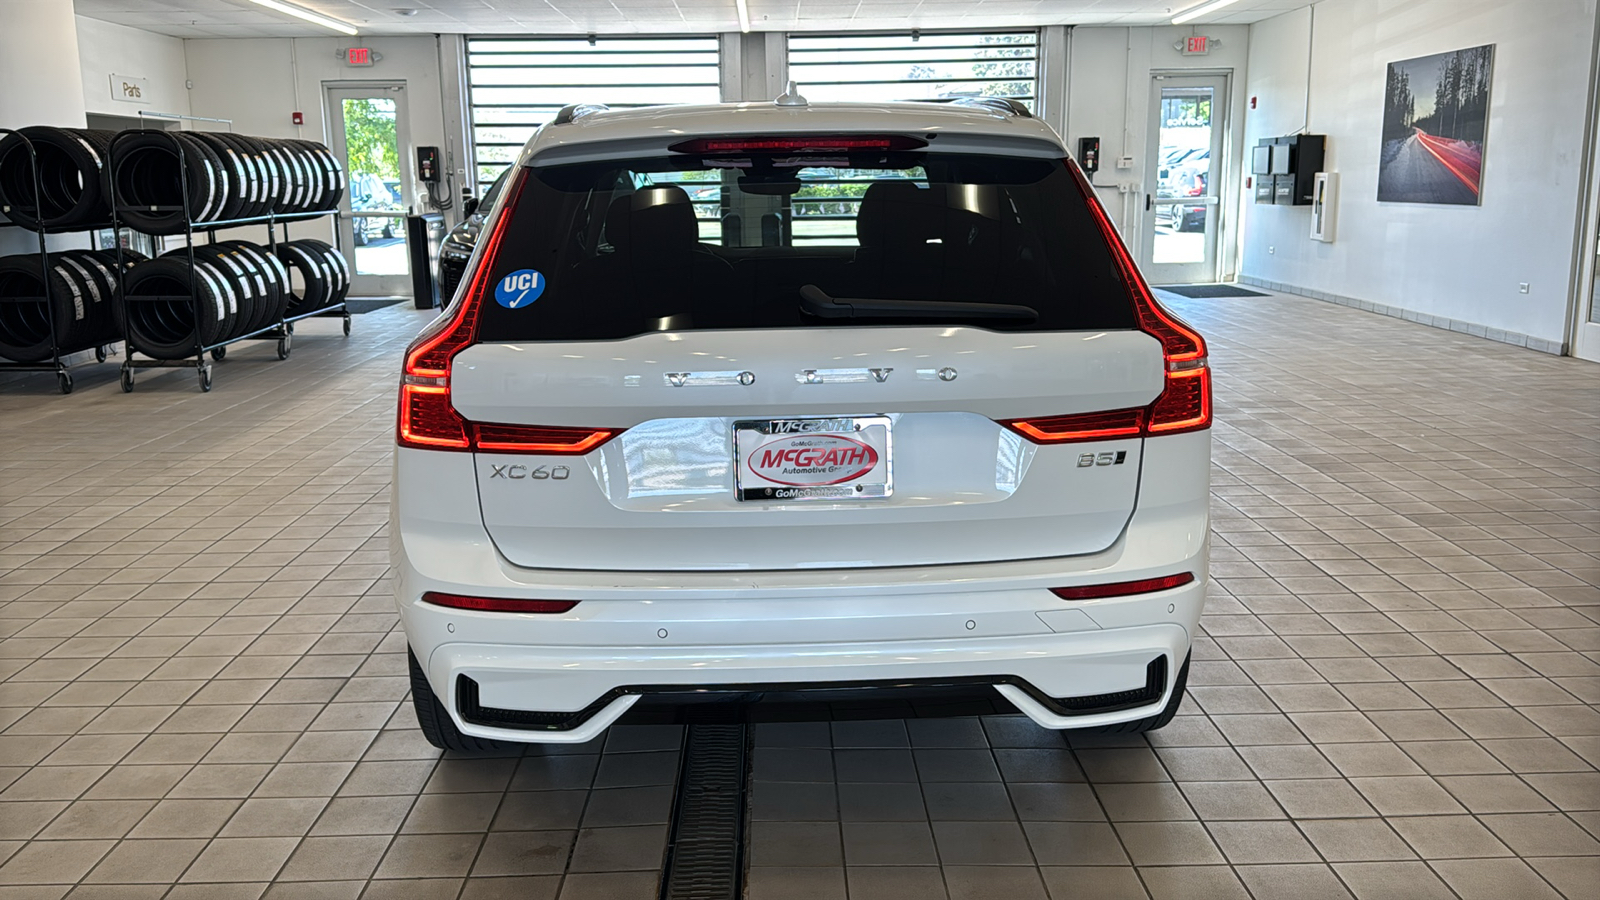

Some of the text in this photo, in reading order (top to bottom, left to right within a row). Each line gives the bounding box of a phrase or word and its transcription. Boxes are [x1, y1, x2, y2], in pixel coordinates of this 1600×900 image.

[1188, 36, 1207, 52] EXIT
[349, 48, 368, 64] EXIT
[122, 82, 141, 98] Parts
[503, 271, 539, 293] UCI
[665, 366, 958, 388] VOLVO
[1077, 452, 1114, 468] B5
[782, 467, 827, 475] Automotive
